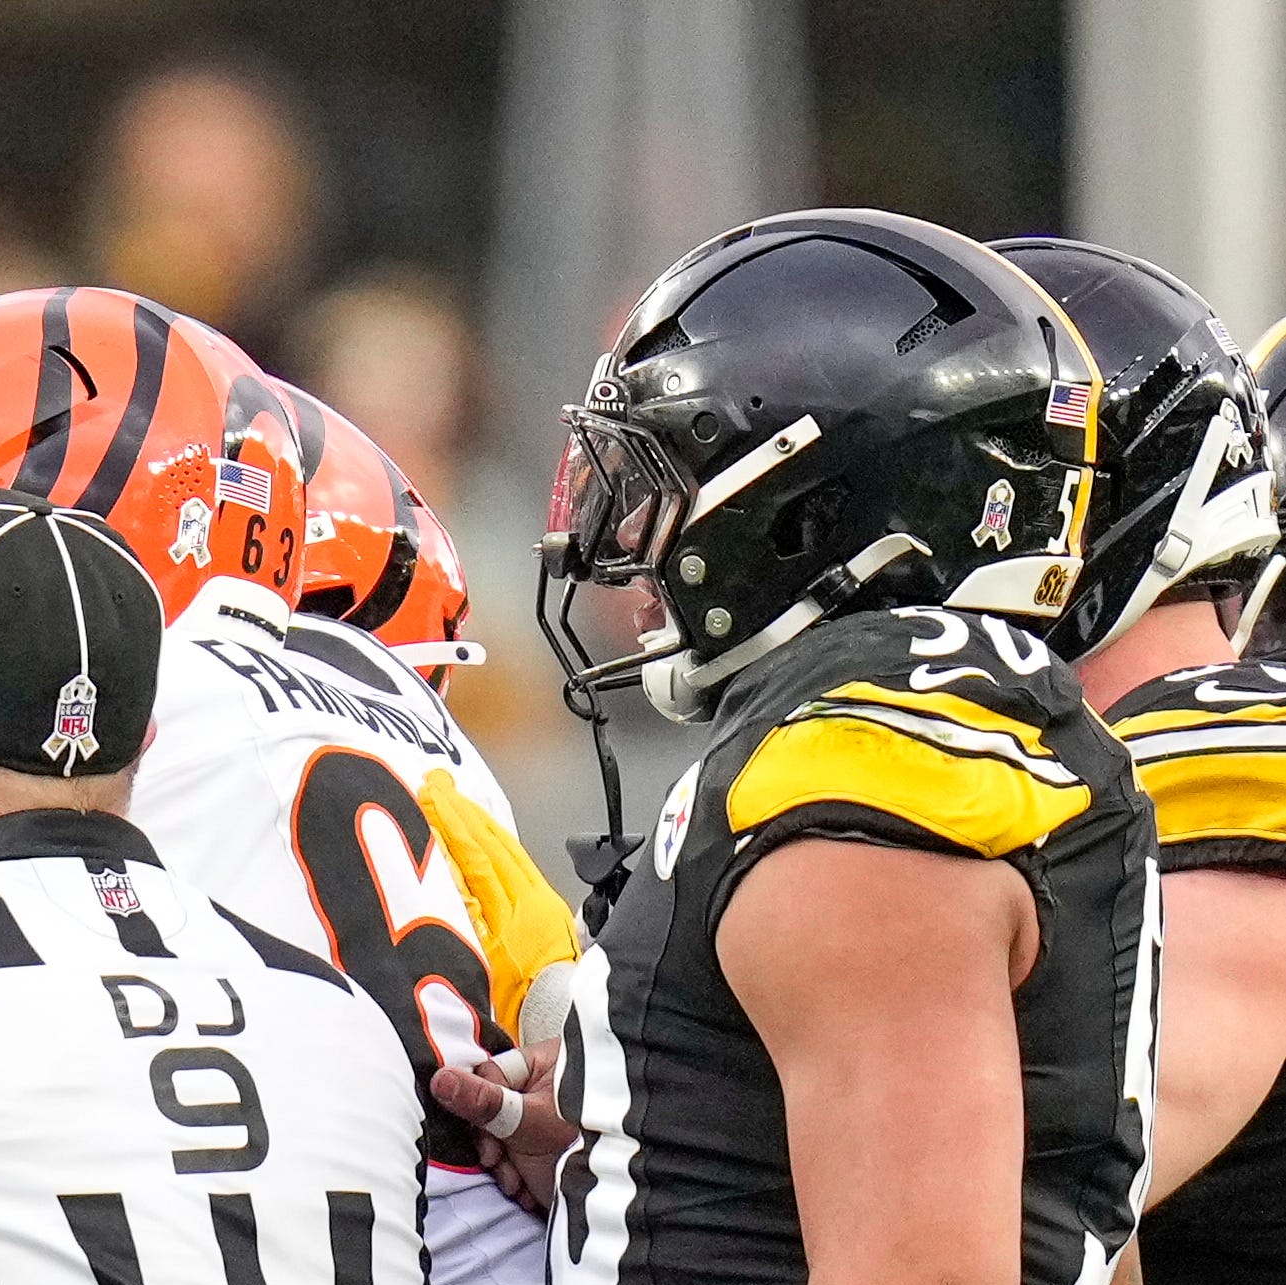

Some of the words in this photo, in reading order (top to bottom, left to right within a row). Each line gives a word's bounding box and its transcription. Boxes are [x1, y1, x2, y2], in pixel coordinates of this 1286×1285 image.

[986, 511, 1007, 529] NFL
[241, 513, 296, 588] 63
[59, 715, 90, 739] NFL
[100, 889, 138, 913] NFL
[100, 974, 247, 1038] DJ
[148, 1046, 270, 1175] 9
